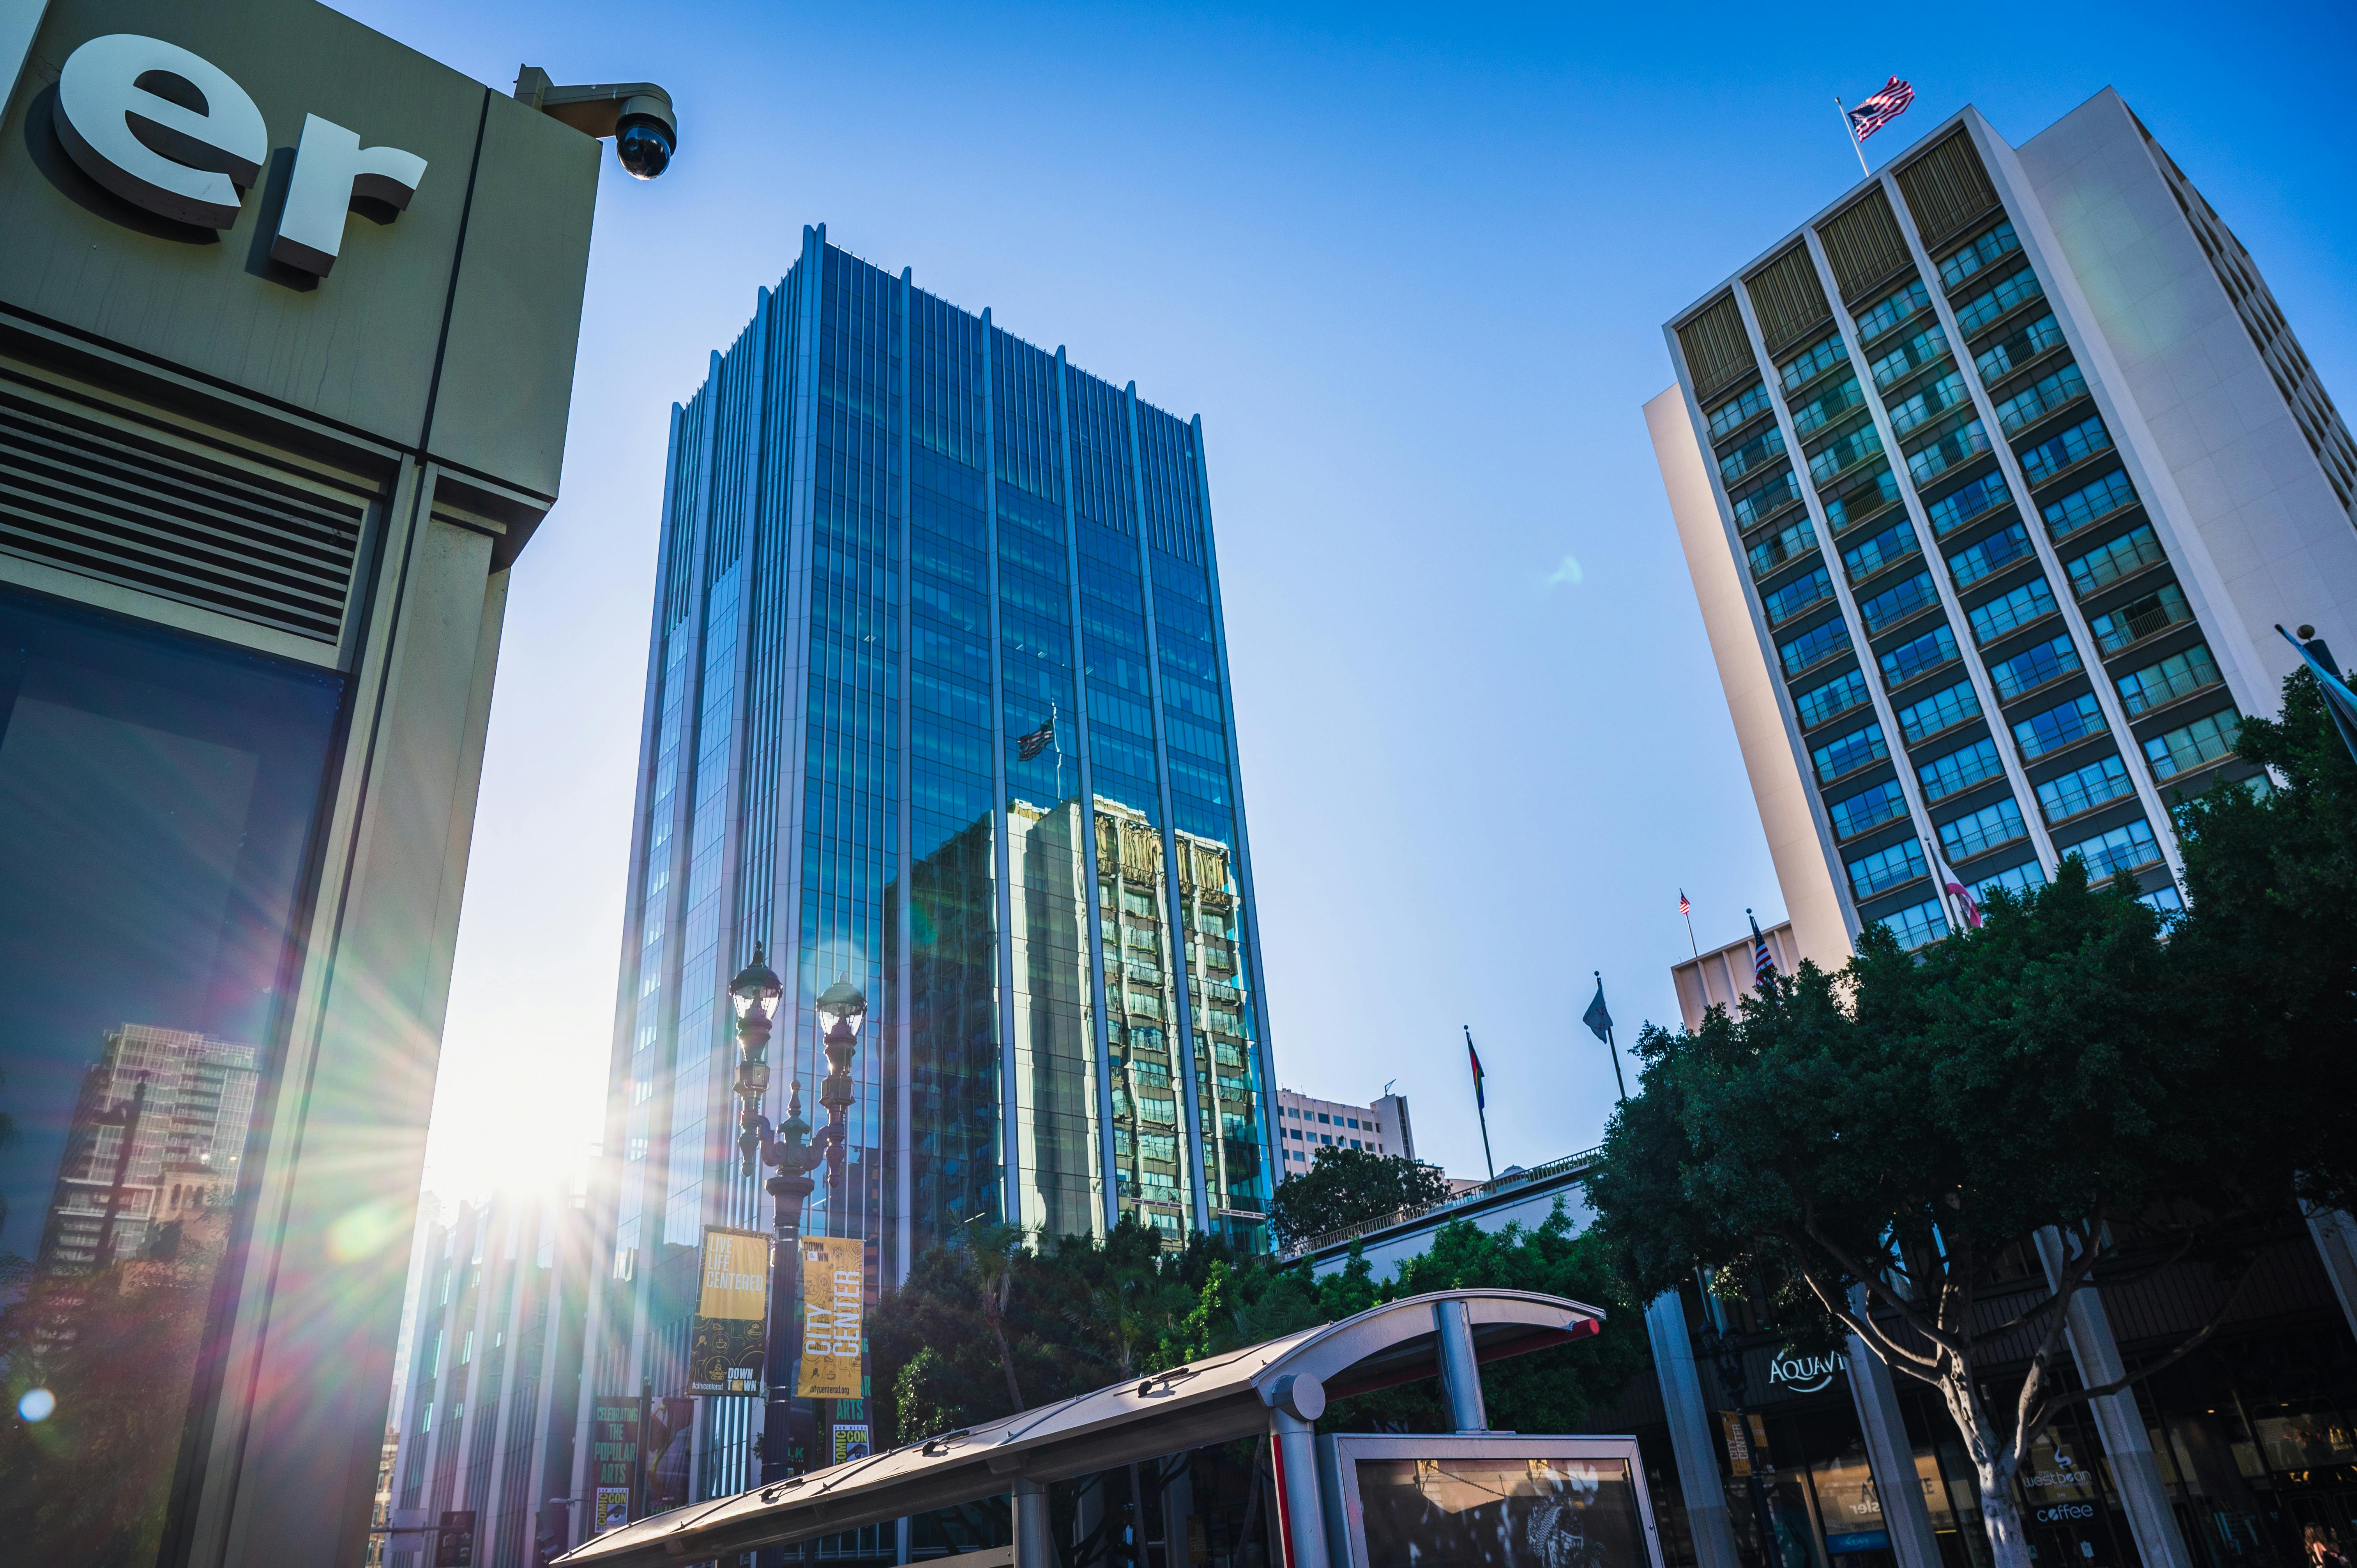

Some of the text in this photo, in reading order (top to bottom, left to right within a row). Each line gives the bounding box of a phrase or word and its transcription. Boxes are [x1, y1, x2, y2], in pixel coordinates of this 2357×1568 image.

[53, 34, 428, 279] er
[710, 1235, 733, 1254] LIVE
[804, 1241, 823, 1252] DOWN
[708, 1253, 730, 1271] LIFE
[804, 1251, 828, 1262] TWN
[706, 1271, 763, 1291] CENTERED
[805, 1270, 860, 1357] CITY CENTER
[728, 1367, 753, 1379] DOWN
[1769, 1351, 1845, 1383] AQUAVI
[692, 1382, 723, 1391] #citycentersd
[727, 1379, 757, 1391] TWN
[810, 1384, 849, 1395] citycentersd.org
[597, 1407, 638, 1422] CELEBRATING
[836, 1399, 864, 1420] ARTS
[609, 1423, 624, 1440] THE
[847, 1430, 867, 1443] CON
[1727, 1439, 1739, 1459] CITY
[1732, 1424, 1749, 1459] CENTER
[594, 1443, 636, 1462] POPULAR
[601, 1464, 626, 1483] ARTS
[597, 1493, 626, 1525] COMIC CON
[2037, 1504, 2093, 1522] coffee
